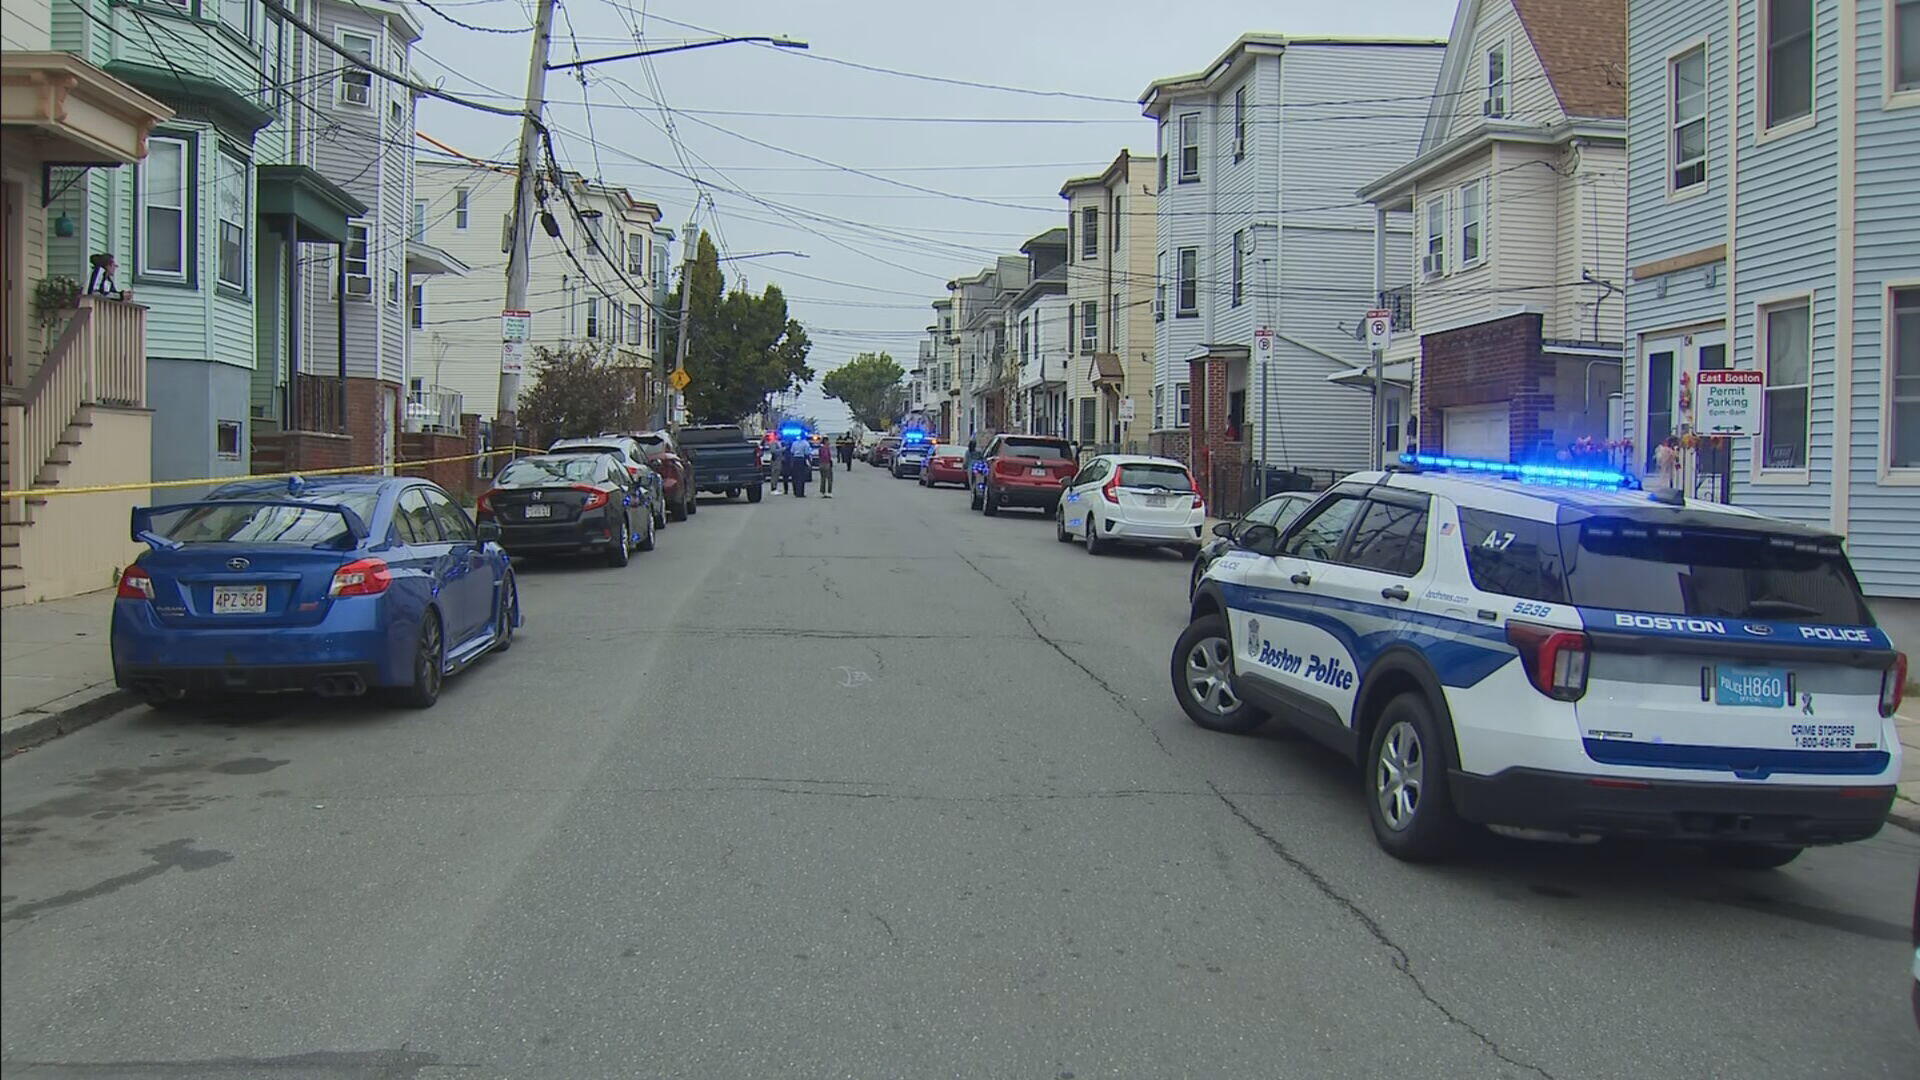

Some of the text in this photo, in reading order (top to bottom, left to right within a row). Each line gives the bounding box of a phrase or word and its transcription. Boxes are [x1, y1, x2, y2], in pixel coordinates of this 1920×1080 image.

[1700, 373, 1760, 383] East Boston
[1710, 387, 1745, 396] Permit
[1707, 397, 1748, 409] Parking
[216, 593, 264, 607] 4PZ 368
[1513, 601, 1551, 618] 5238
[1615, 613, 1872, 643] BOSTON POLICE
[1258, 640, 1353, 690] Boston Police
[1720, 675, 1782, 698] POLICE H860
[1791, 725, 1855, 737] CRIME STOPPERS
